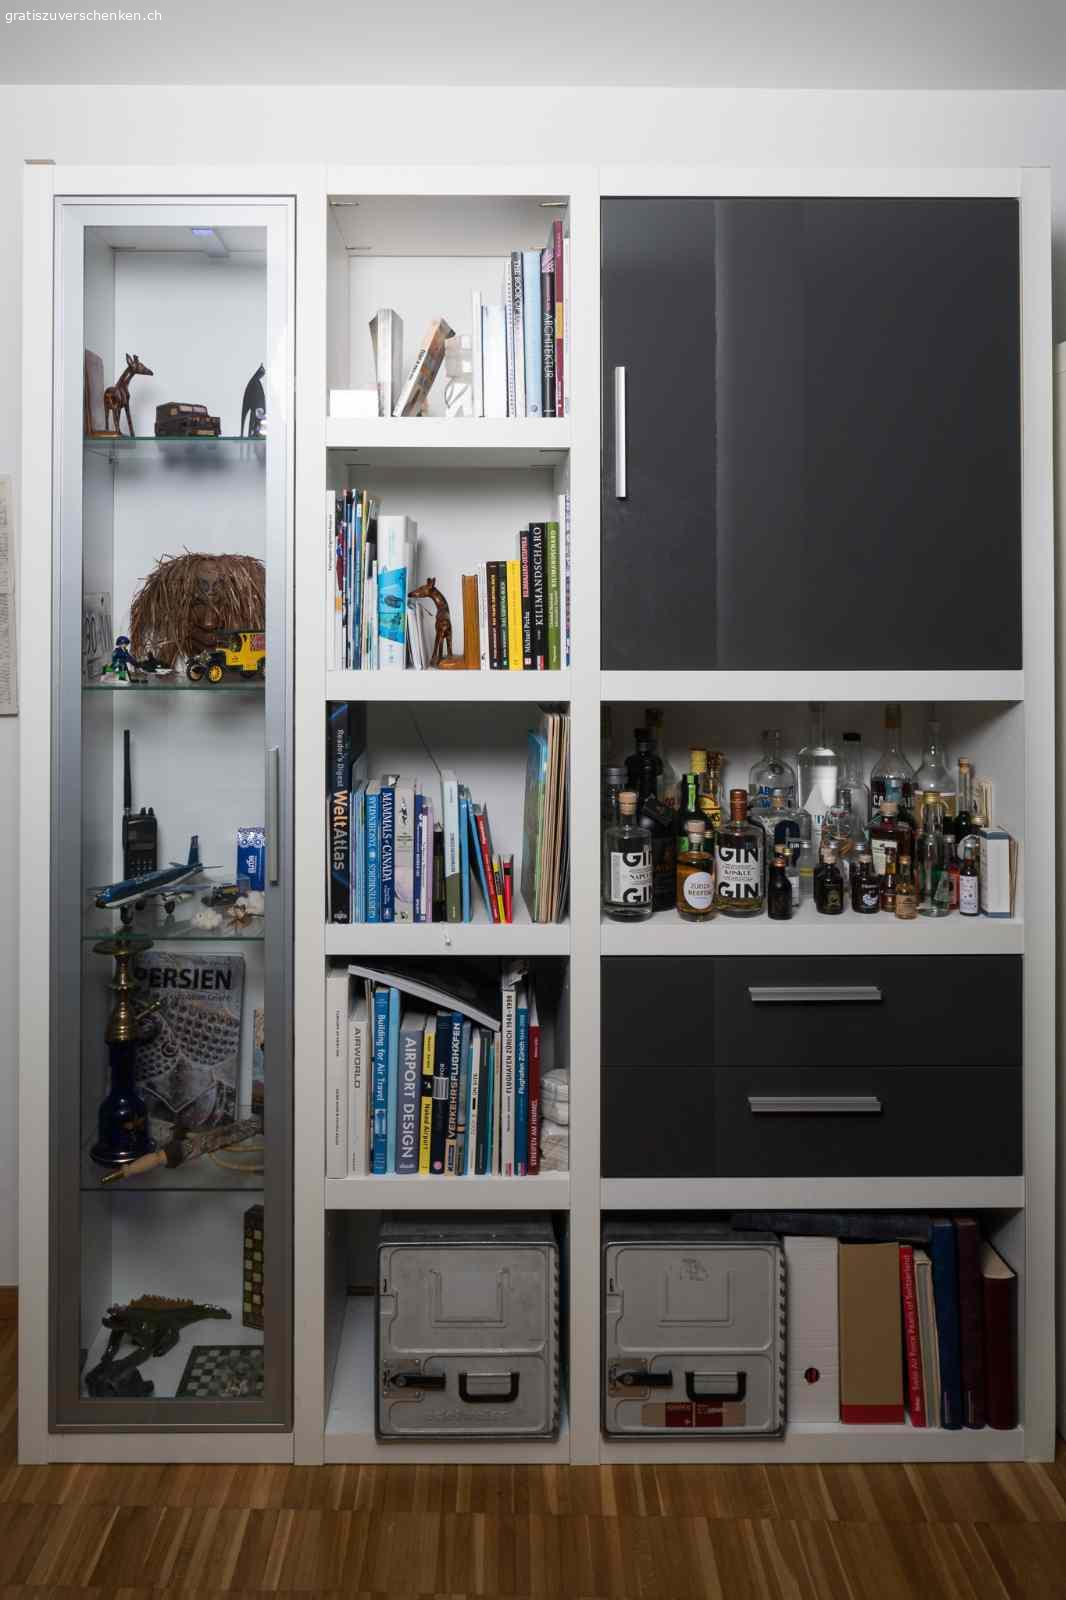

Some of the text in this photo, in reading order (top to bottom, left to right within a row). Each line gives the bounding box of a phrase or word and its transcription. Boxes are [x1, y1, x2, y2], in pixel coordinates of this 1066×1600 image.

[543, 312, 553, 378] ARCHITEKTUR
[533, 527, 544, 625] KILIMANDSCHARO
[335, 763, 344, 787] Digest
[333, 790, 347, 871] WeltAtlas
[382, 792, 392, 839] MAMMALS
[382, 844, 392, 881] CANADA
[719, 848, 758, 863] GIN
[719, 882, 759, 898] GIN
[376, 1014, 385, 1102] Building for Air Travel
[505, 1030, 513, 1054] ZÜRICH
[505, 1056, 513, 1094] FLUGHAFEN
[518, 1062, 526, 1094] Flughafen
[401, 1038, 416, 1158] AIRPORT DESIGN
[530, 1126, 537, 1136] AM
